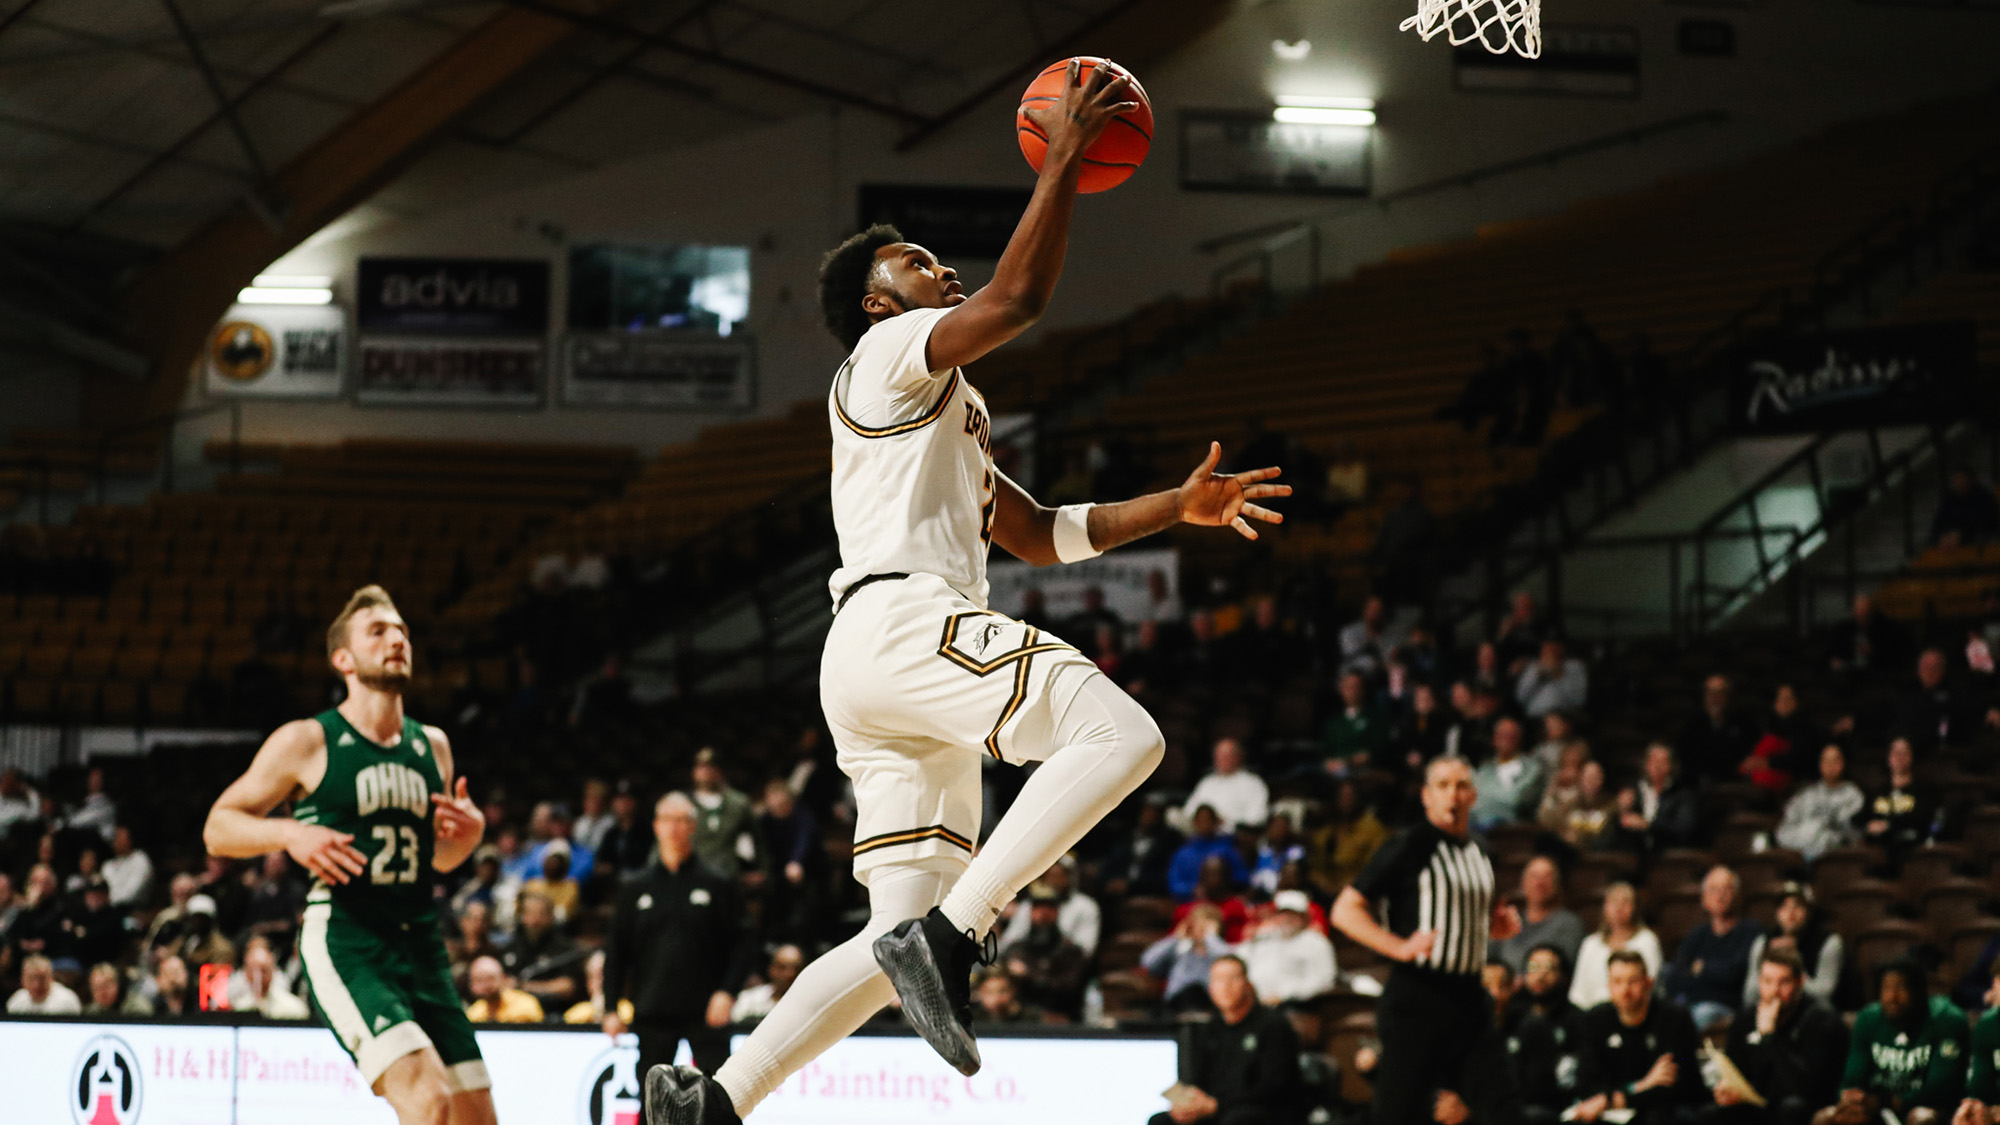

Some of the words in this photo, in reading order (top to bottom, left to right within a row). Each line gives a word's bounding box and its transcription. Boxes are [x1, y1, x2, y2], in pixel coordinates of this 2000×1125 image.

[381, 269, 519, 308] advia
[356, 762, 428, 819] OHIO
[371, 825, 419, 884] 23
[239, 1047, 359, 1096] Painting
[799, 1057, 951, 1114] Painting
